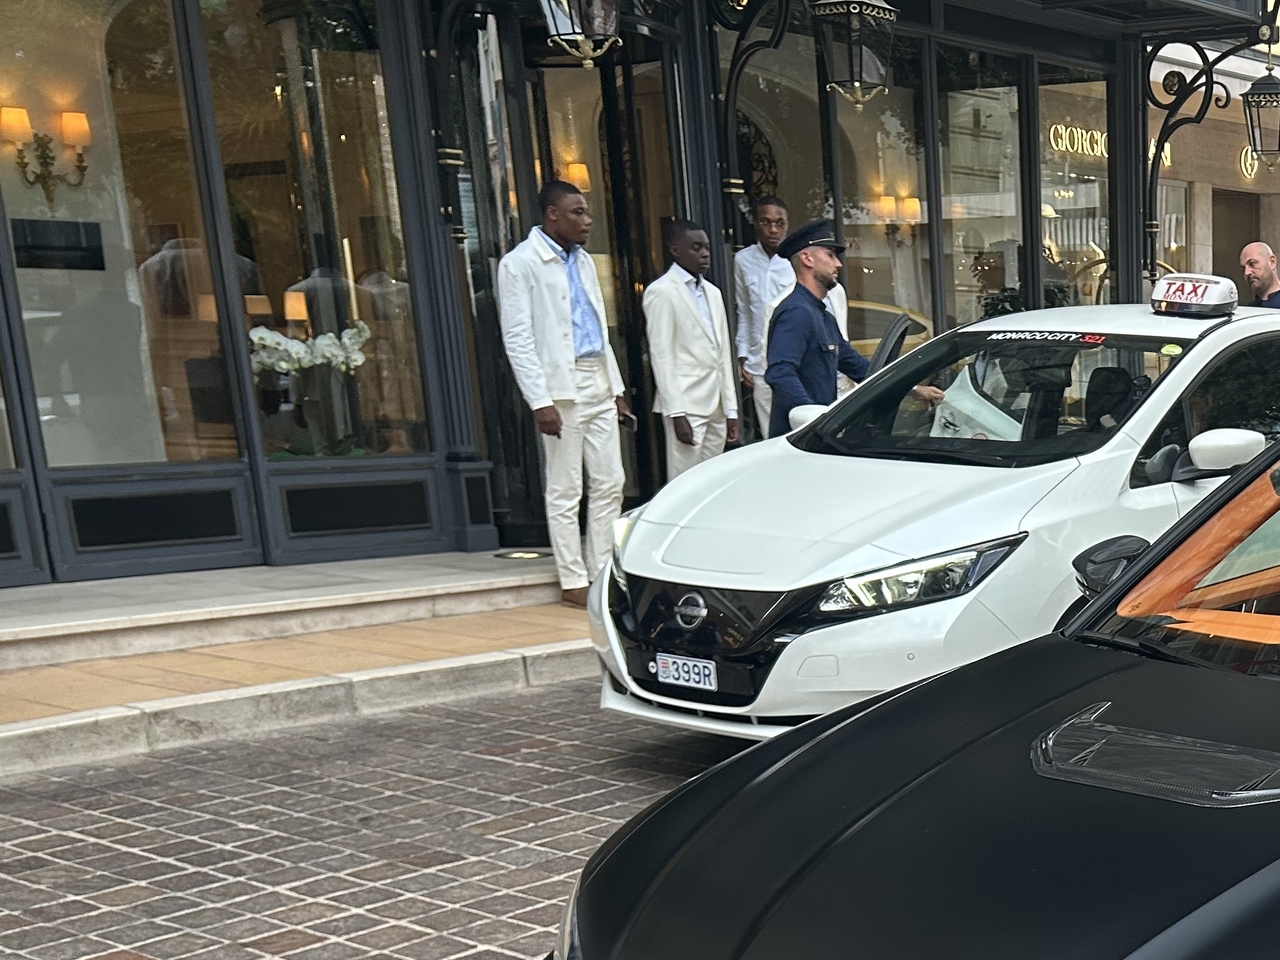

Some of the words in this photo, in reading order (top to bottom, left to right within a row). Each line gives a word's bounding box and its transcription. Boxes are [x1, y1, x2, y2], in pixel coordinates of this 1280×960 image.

[1165, 282, 1209, 298] TAXI
[1163, 293, 1204, 303] MONACO
[987, 332, 1049, 341] MONACO
[1046, 332, 1082, 341] CITY
[1080, 334, 1106, 344] 321
[671, 660, 713, 687] 399R
